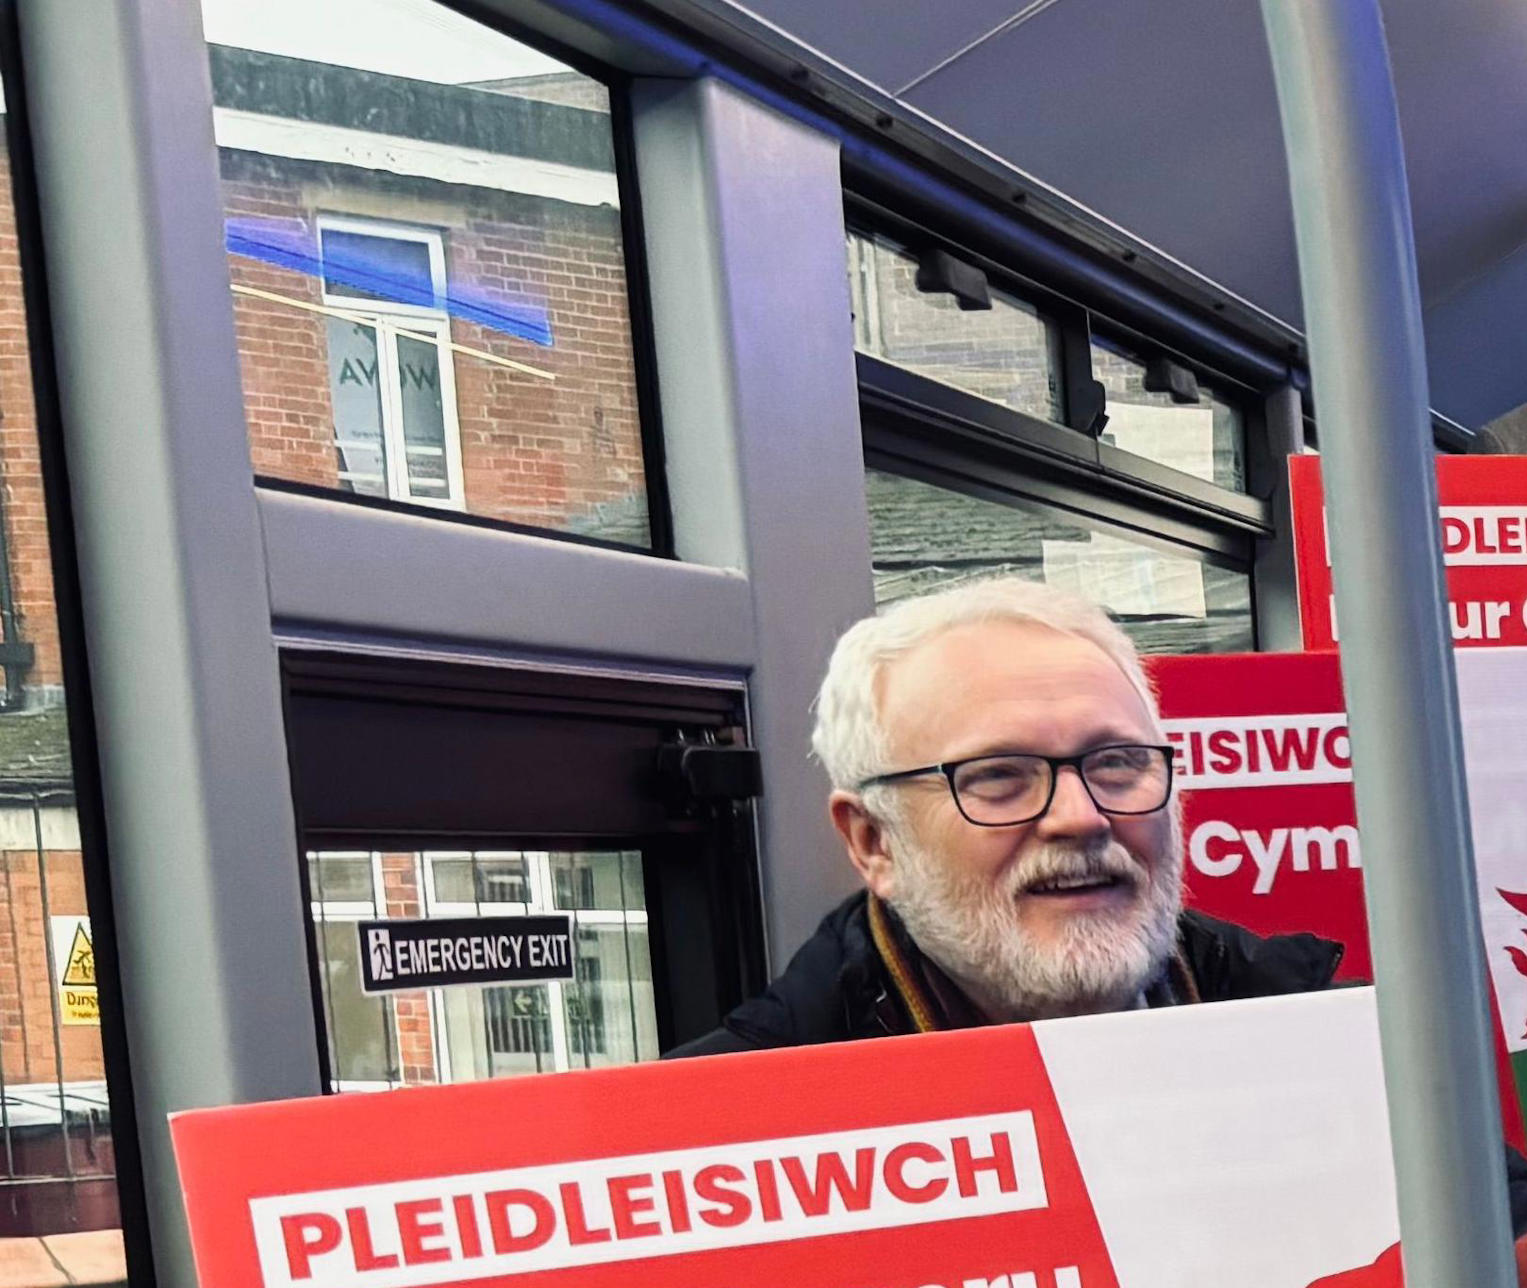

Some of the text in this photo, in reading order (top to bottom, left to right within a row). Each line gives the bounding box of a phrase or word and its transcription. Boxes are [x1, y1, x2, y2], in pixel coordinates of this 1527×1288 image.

[1189, 821, 1363, 893] Cym
[395, 935, 567, 974] EMERGENCY EXIT
[280, 1132, 1018, 1279] PLEIDLEISIWCH
